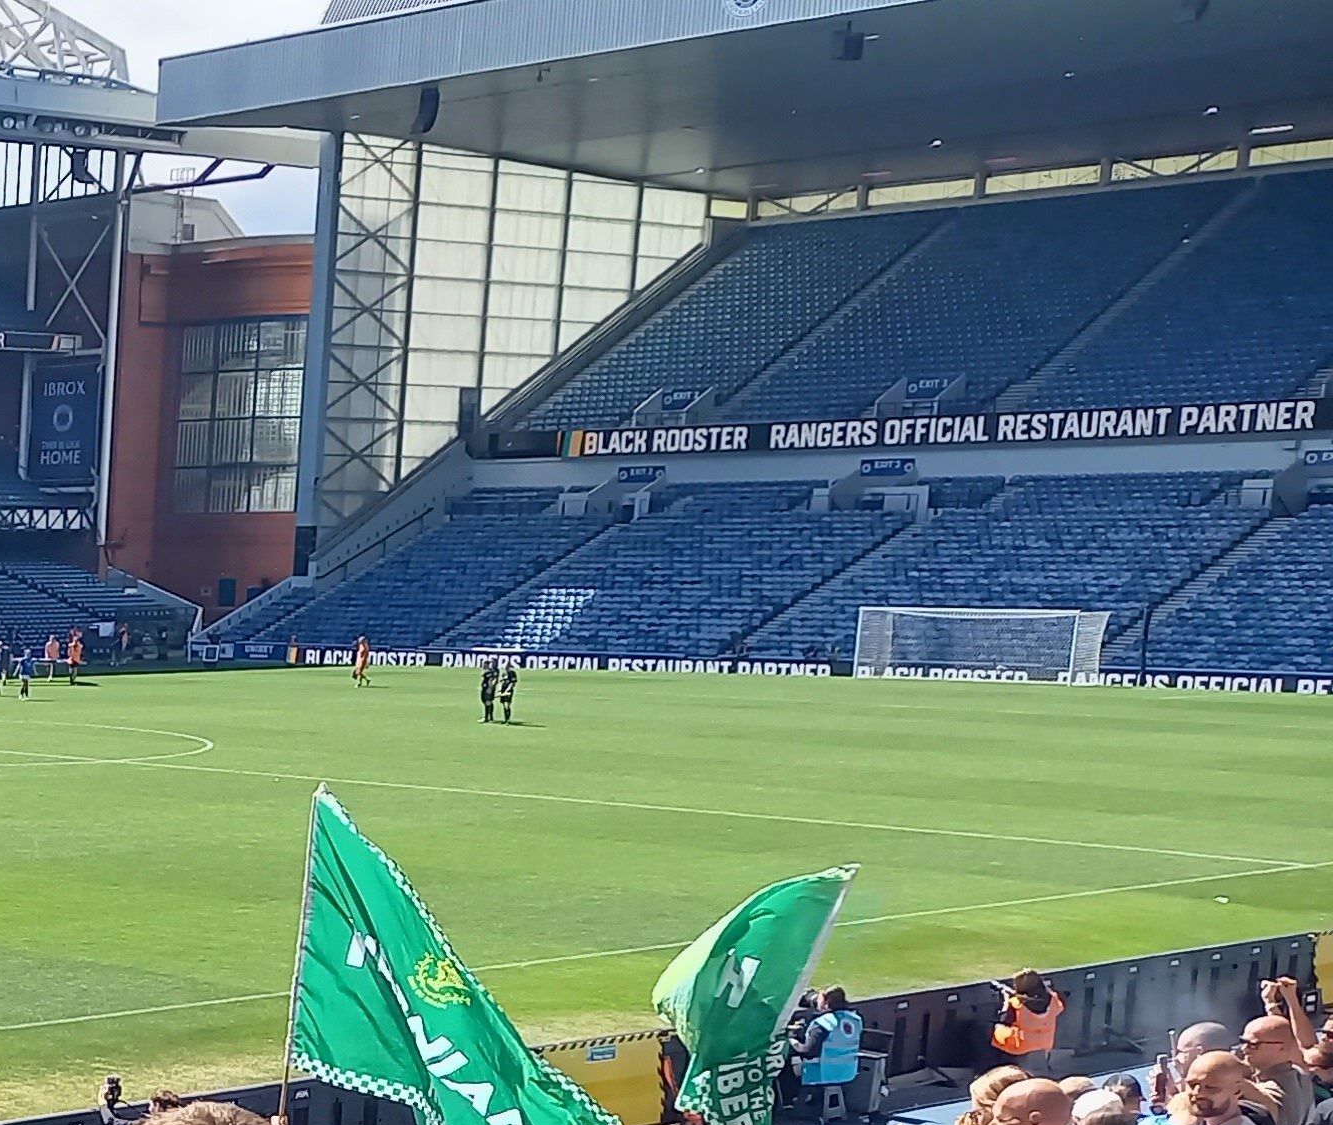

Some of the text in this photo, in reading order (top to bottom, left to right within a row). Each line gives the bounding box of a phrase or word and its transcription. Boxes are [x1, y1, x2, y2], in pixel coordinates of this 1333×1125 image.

[44, 381, 86, 397] IBROX
[584, 400, 1316, 456] BLACK ROOSTER RANGERS OFFICIAL RESTAURANT PARTNER
[40, 450, 81, 465] HOME
[305, 649, 427, 667] BLACK OOSTER
[525, 655, 599, 671] OFFICIAL
[749, 1085, 767, 1123] THE
